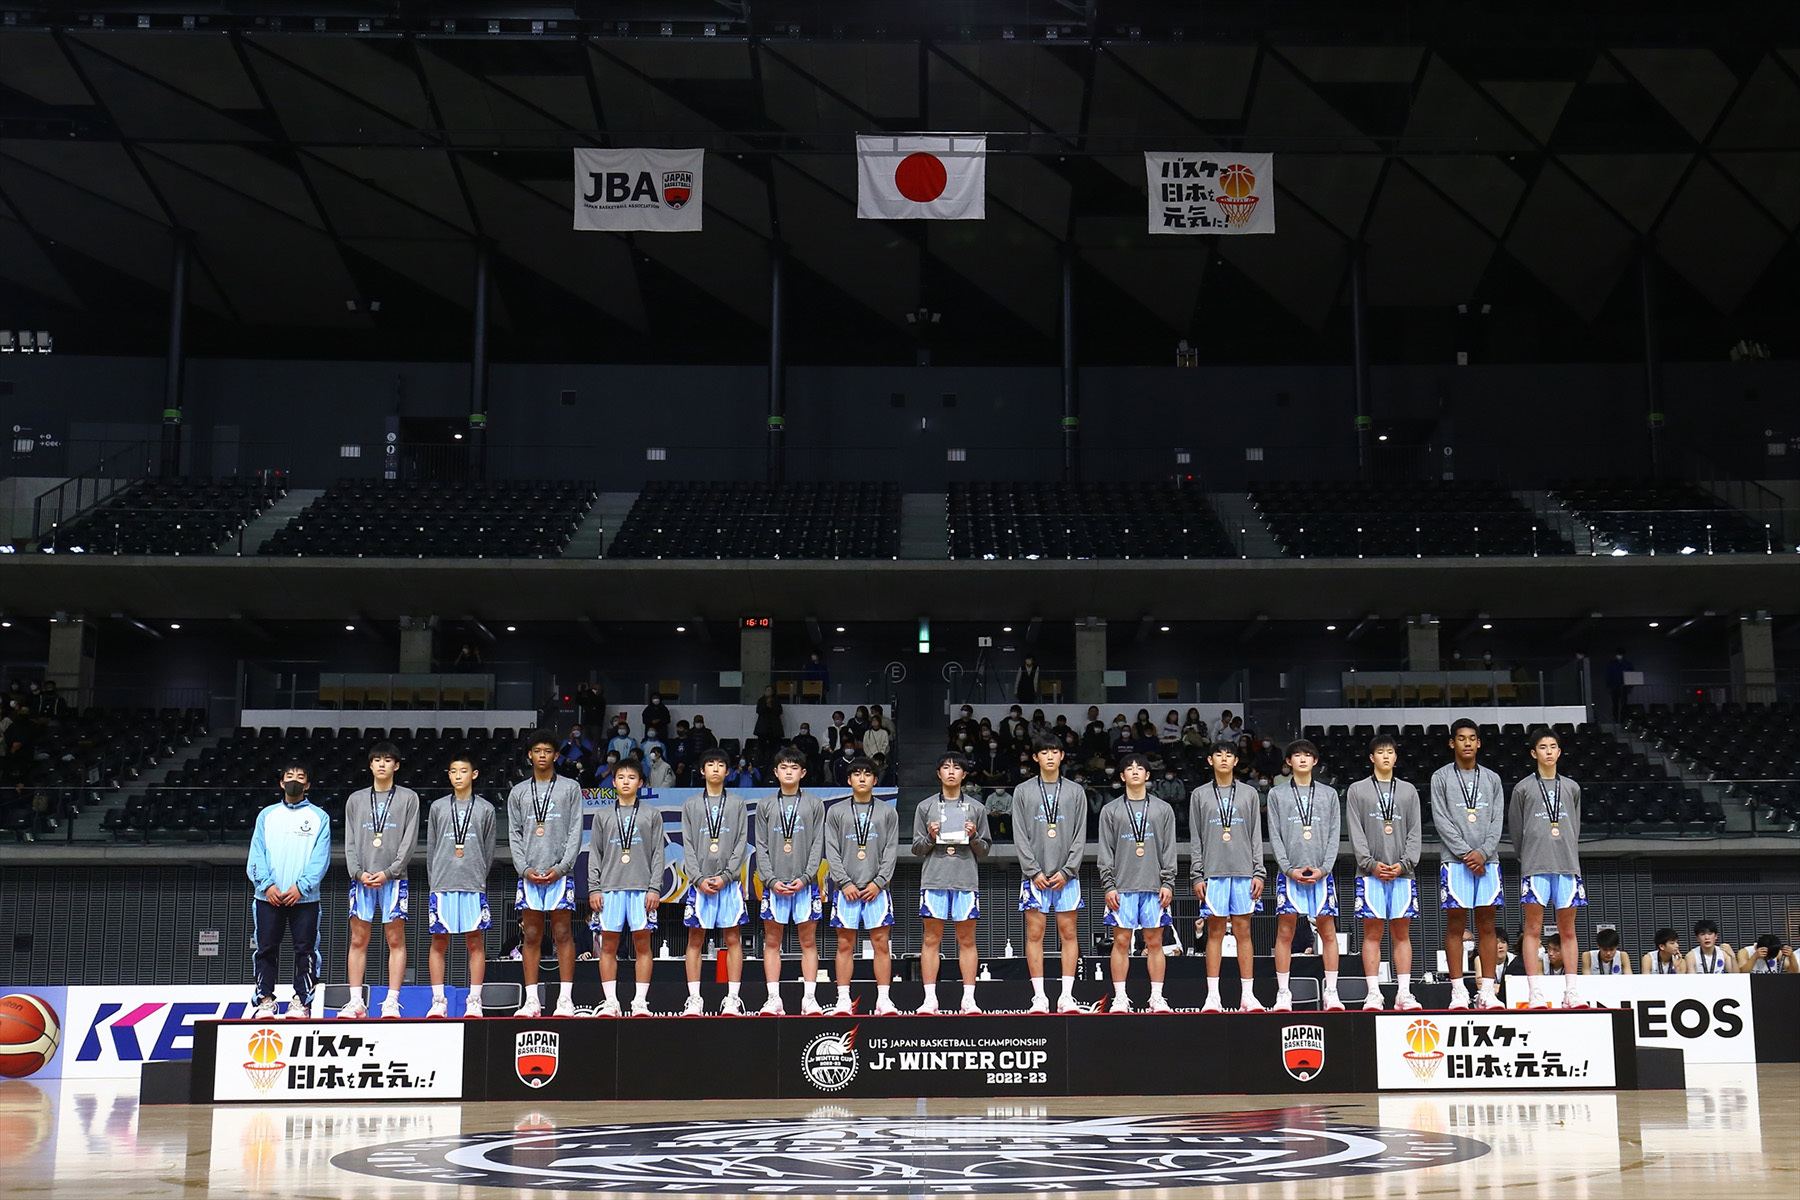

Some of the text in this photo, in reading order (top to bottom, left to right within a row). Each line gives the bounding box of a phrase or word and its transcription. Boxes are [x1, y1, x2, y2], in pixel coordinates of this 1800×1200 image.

[664, 173, 691, 183] JAPAN
[584, 171, 660, 203] JBA
[1161, 183, 1215, 203] 日本を
[584, 203, 660, 212] JAPAN BASKETBALL ASSOCIATION
[1163, 205, 1230, 228] 元気に!
[746, 618, 769, 627] 16:10
[891, 666, 900, 678] E
[1077, 957, 1083, 965] 3
[1077, 965, 1083, 973] 2
[518, 1033, 557, 1047] JAPAN
[1283, 1028, 1322, 1042] JAPAN
[1447, 1020, 1531, 1047] バスケで
[289, 1030, 379, 1057] バスケで
[868, 1038, 1048, 1049] U15 JAPAN BASKETBALL CHAMPIONSHIP
[1283, 1040, 1323, 1050] BASKETBALL
[517, 1045, 557, 1056] BASKETBALL
[869, 1050, 1048, 1070] Jr WINTER CUP
[1446, 1050, 1589, 1078] 日本を元気に!
[287, 1060, 437, 1089] 日本を元気に!
[986, 1072, 1048, 1083] 2022-23
[653, 1137, 1080, 1149] WINTER
[1105, 1136, 1316, 1144] CUP
